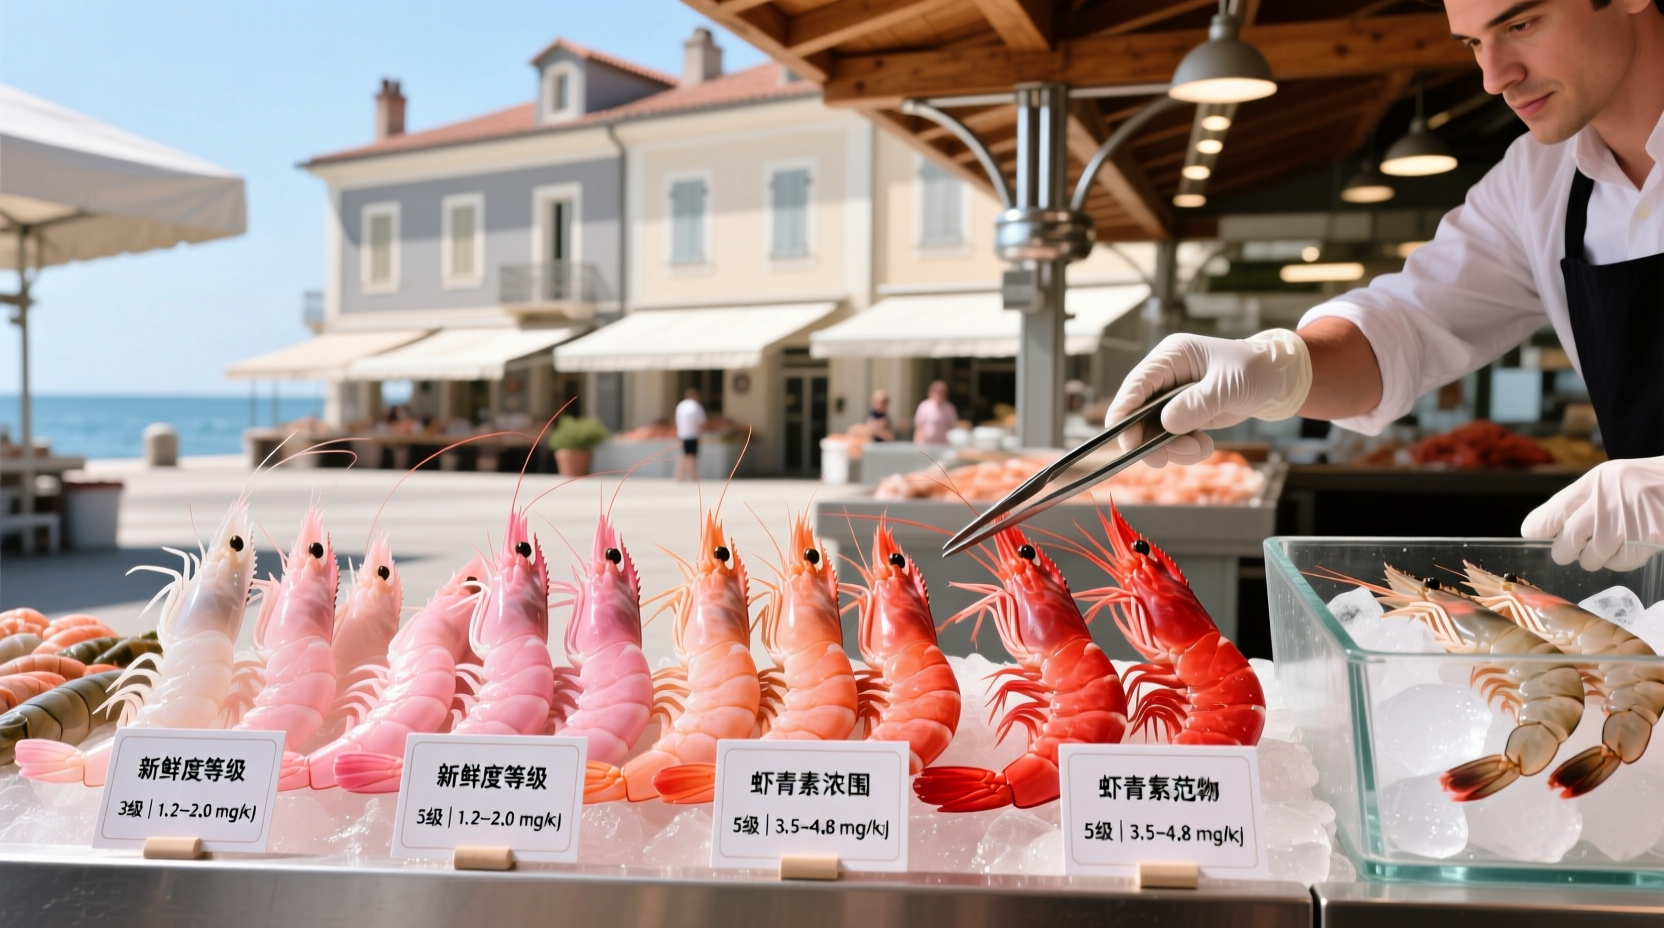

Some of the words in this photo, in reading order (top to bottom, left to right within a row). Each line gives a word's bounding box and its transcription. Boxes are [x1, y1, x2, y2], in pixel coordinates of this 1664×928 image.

[137, 755, 246, 783] 新鲜度等级
[436, 762, 548, 790] 新鲜度等级
[117, 800, 144, 818] 3级
[416, 806, 444, 827] 5级
[732, 814, 760, 836] 5级
[1084, 820, 1114, 842] 5级
